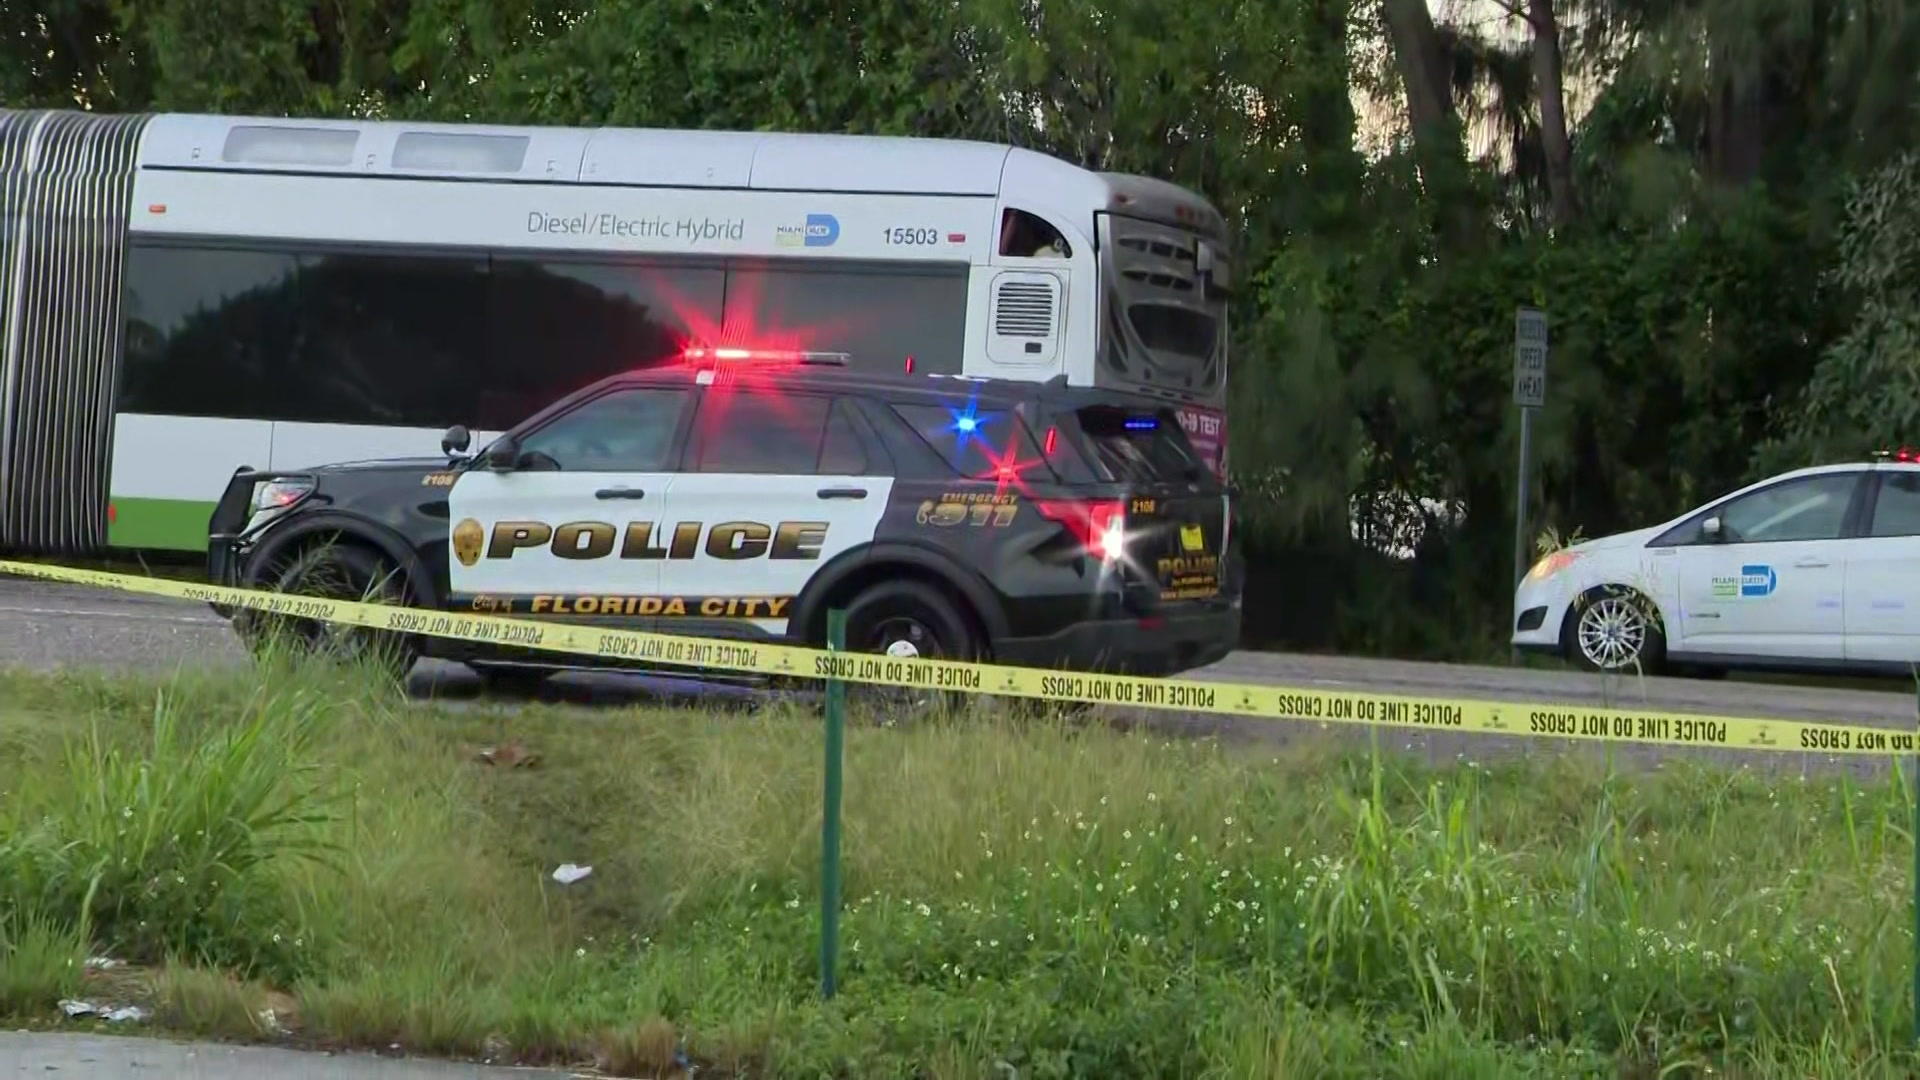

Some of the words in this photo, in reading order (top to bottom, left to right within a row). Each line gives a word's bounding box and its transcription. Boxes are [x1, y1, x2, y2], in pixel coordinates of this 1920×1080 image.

[527, 211, 670, 239] Diesel/Electric
[675, 218, 744, 244] Hybrid
[883, 227, 938, 245] 15503
[1199, 415, 1221, 435] TEST
[942, 492, 1018, 504] EMERGENCY
[486, 521, 830, 561] POLICE
[531, 595, 687, 616] FLORIDA
[701, 595, 791, 617] CITY
[387, 611, 426, 631] CROSS
[428, 615, 455, 634] NOT
[455, 618, 471, 636] DO
[473, 620, 500, 639] LINE
[502, 624, 544, 644] POLICE
[598, 633, 640, 655] CROSS
[641, 638, 663, 658] NOT
[666, 641, 682, 660] DO
[687, 643, 711, 663] LINE
[715, 646, 757, 668] POLICE
[815, 654, 854, 677] CROSS
[859, 658, 881, 680] NOT
[886, 661, 901, 682] DO
[906, 663, 932, 685] LINE
[937, 666, 980, 689] POLICE
[1042, 674, 1082, 698] CROSS
[1088, 678, 1110, 700] NOT
[1115, 681, 1131, 702] DO
[1137, 683, 1164, 705] LINE
[1169, 685, 1215, 709] POLICE
[1279, 694, 1321, 717] CROSS
[1326, 697, 1352, 719] NOT
[1357, 699, 1374, 721] DO
[1379, 701, 1408, 723] LINE
[1413, 703, 1461, 726] POLICE
[1530, 711, 1576, 734] CROSS
[1580, 714, 1608, 736] NOT
[1613, 716, 1633, 737] DO
[1638, 717, 1668, 739] LINE
[1675, 719, 1726, 742] POLICE
[1801, 727, 1850, 750] CROSS
